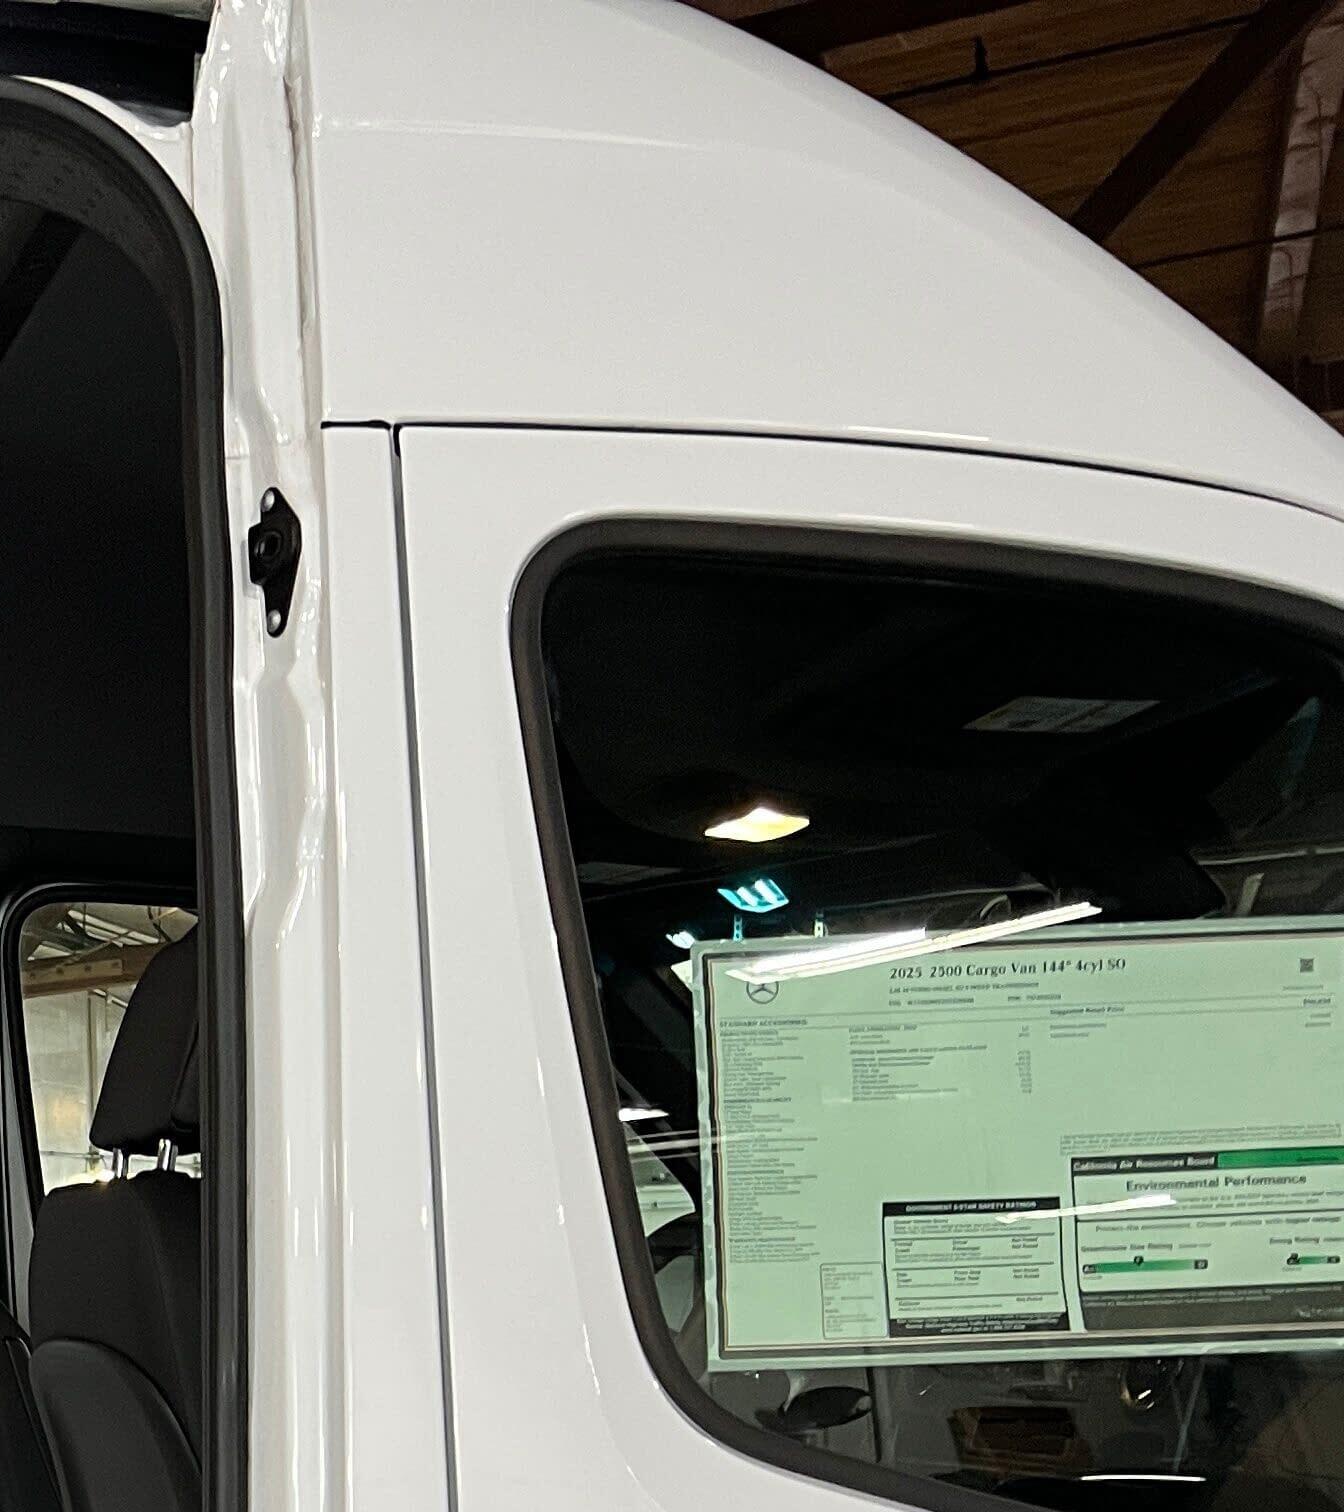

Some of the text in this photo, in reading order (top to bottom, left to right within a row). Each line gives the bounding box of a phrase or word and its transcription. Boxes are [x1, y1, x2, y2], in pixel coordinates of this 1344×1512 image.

[889, 966, 923, 979] 2025
[966, 964, 1007, 977] Cargo
[1011, 961, 1037, 974] Van
[1076, 958, 1103, 975] 4cyl
[1126, 1174, 1308, 1192] Environmental Performance
